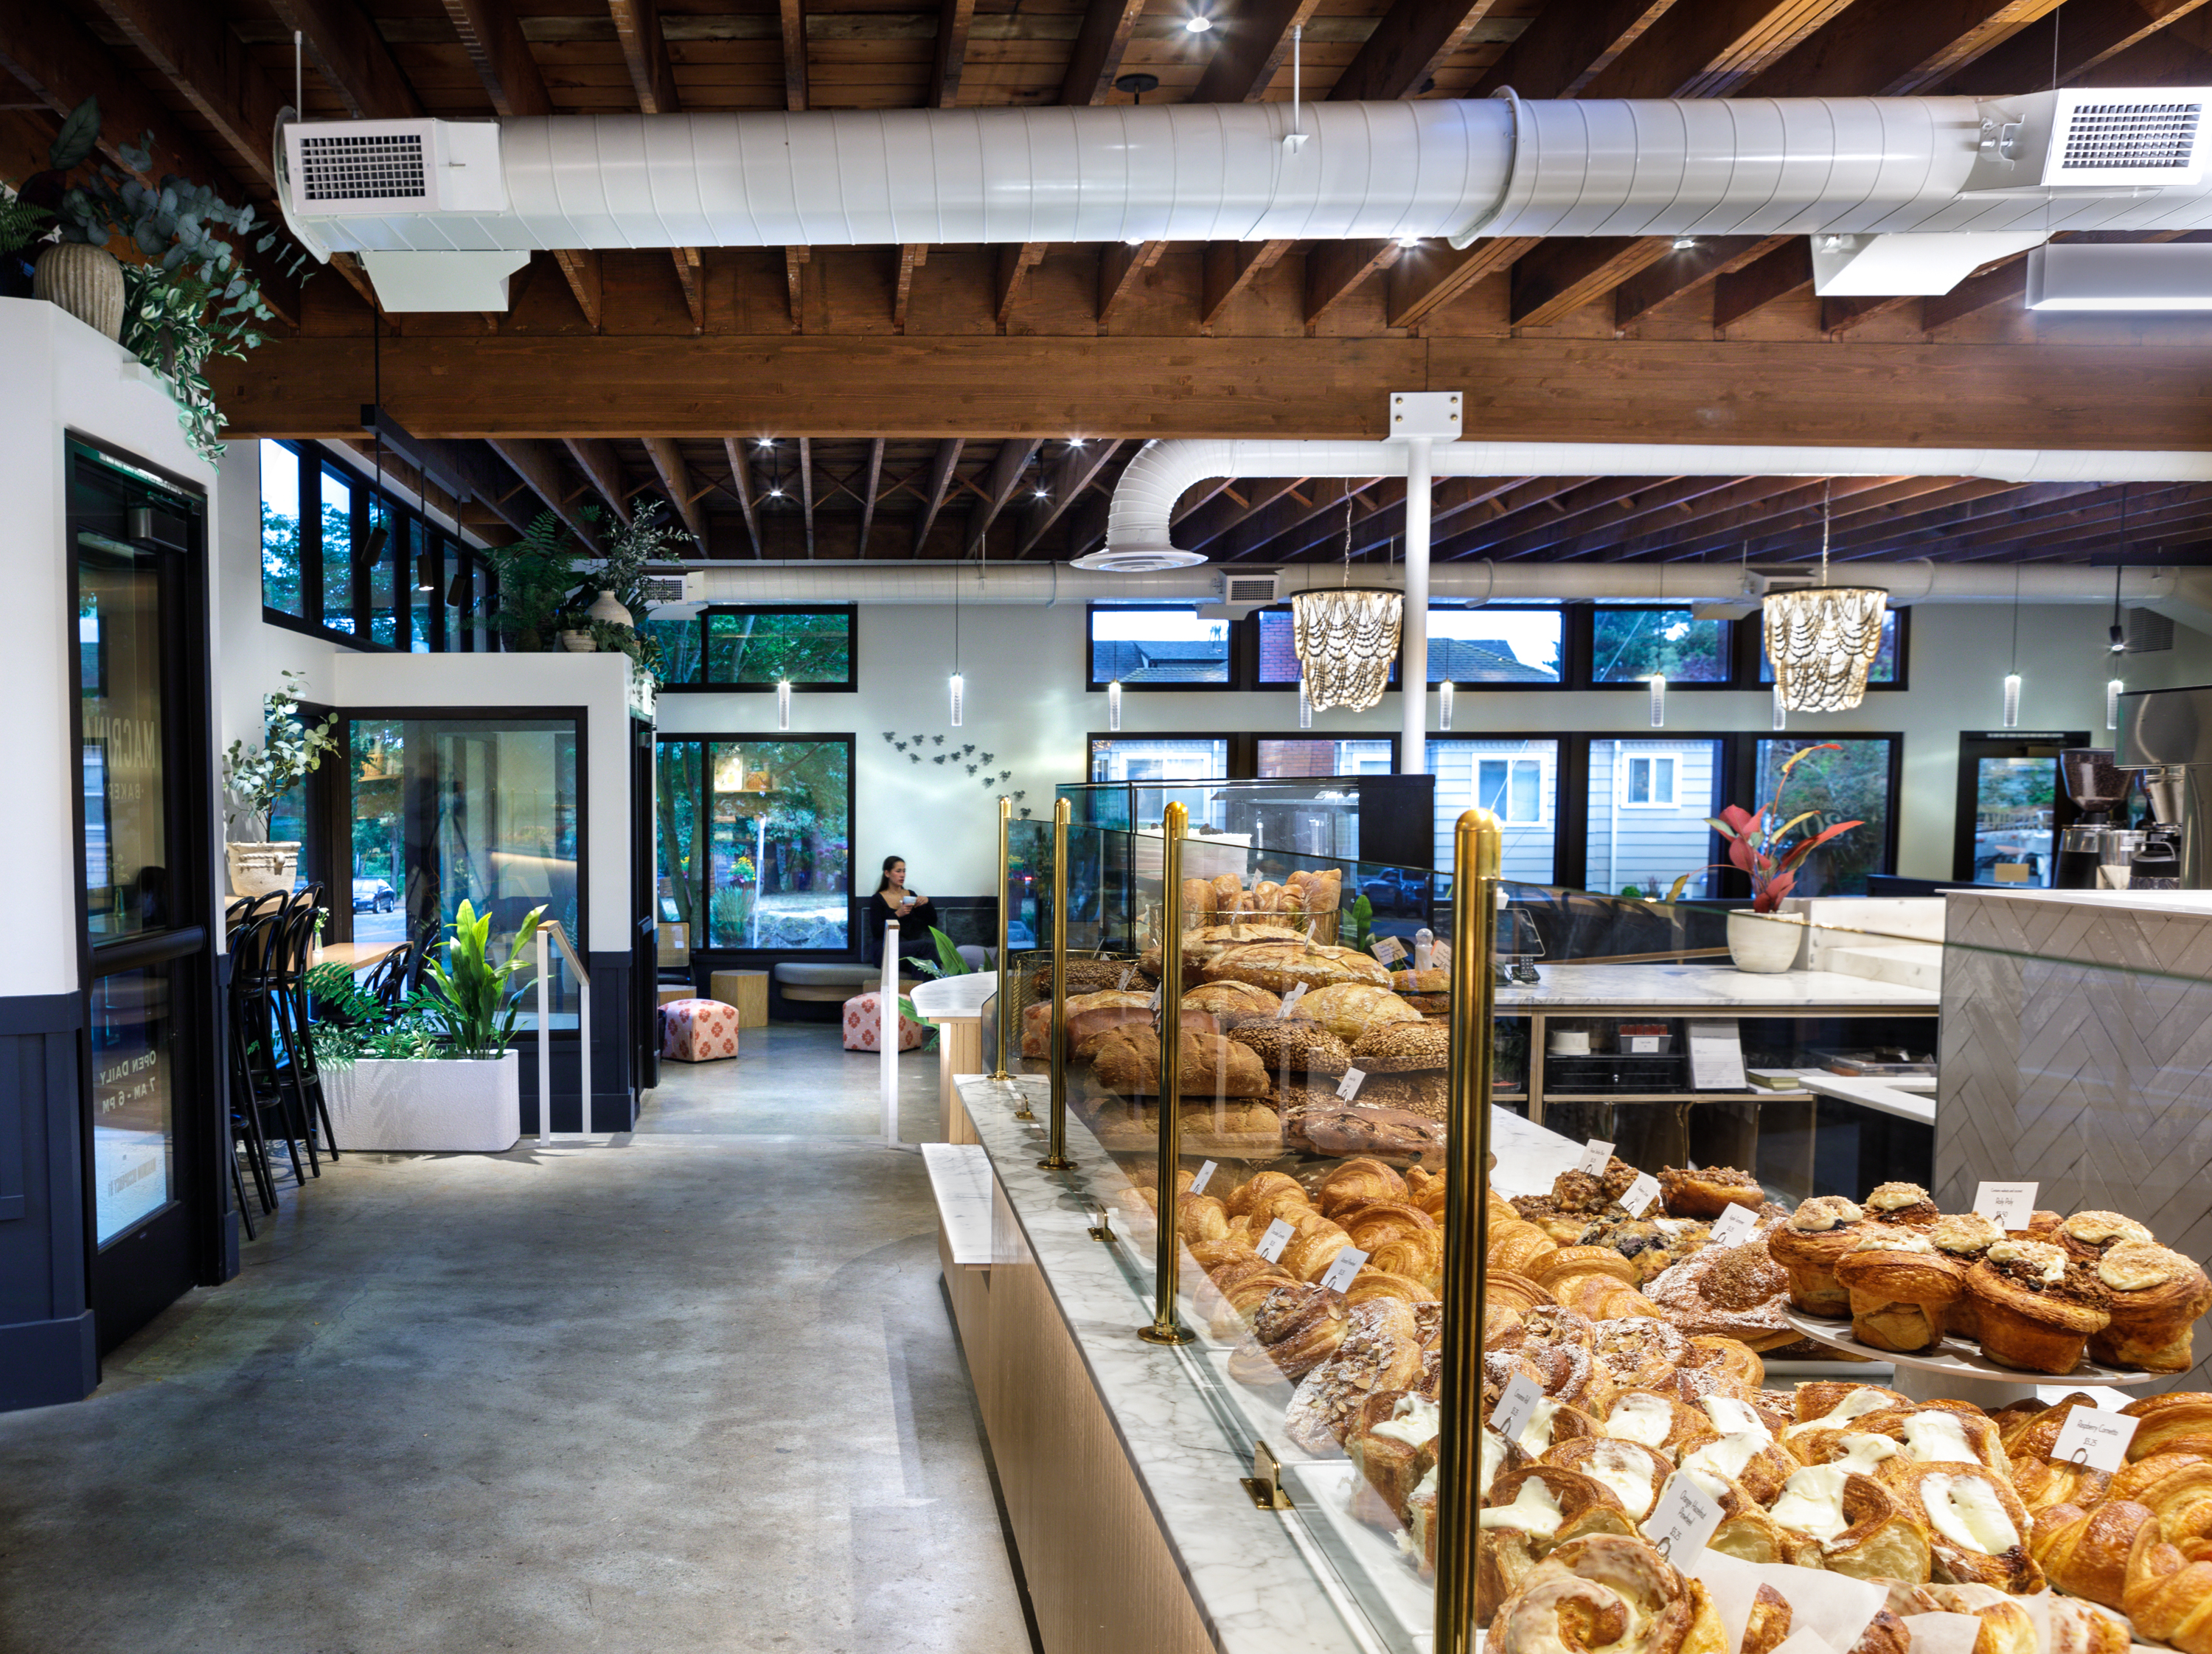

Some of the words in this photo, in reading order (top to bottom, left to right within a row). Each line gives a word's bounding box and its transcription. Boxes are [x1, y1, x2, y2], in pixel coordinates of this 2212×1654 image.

[2076, 1419, 2098, 1433] Raspberry
[2098, 1424, 2118, 1436] Cornetto
[1680, 1490, 1693, 1508] Orange
[1691, 1500, 1707, 1520] Hazelnut
[1677, 1507, 1695, 1526] Pinwheel
